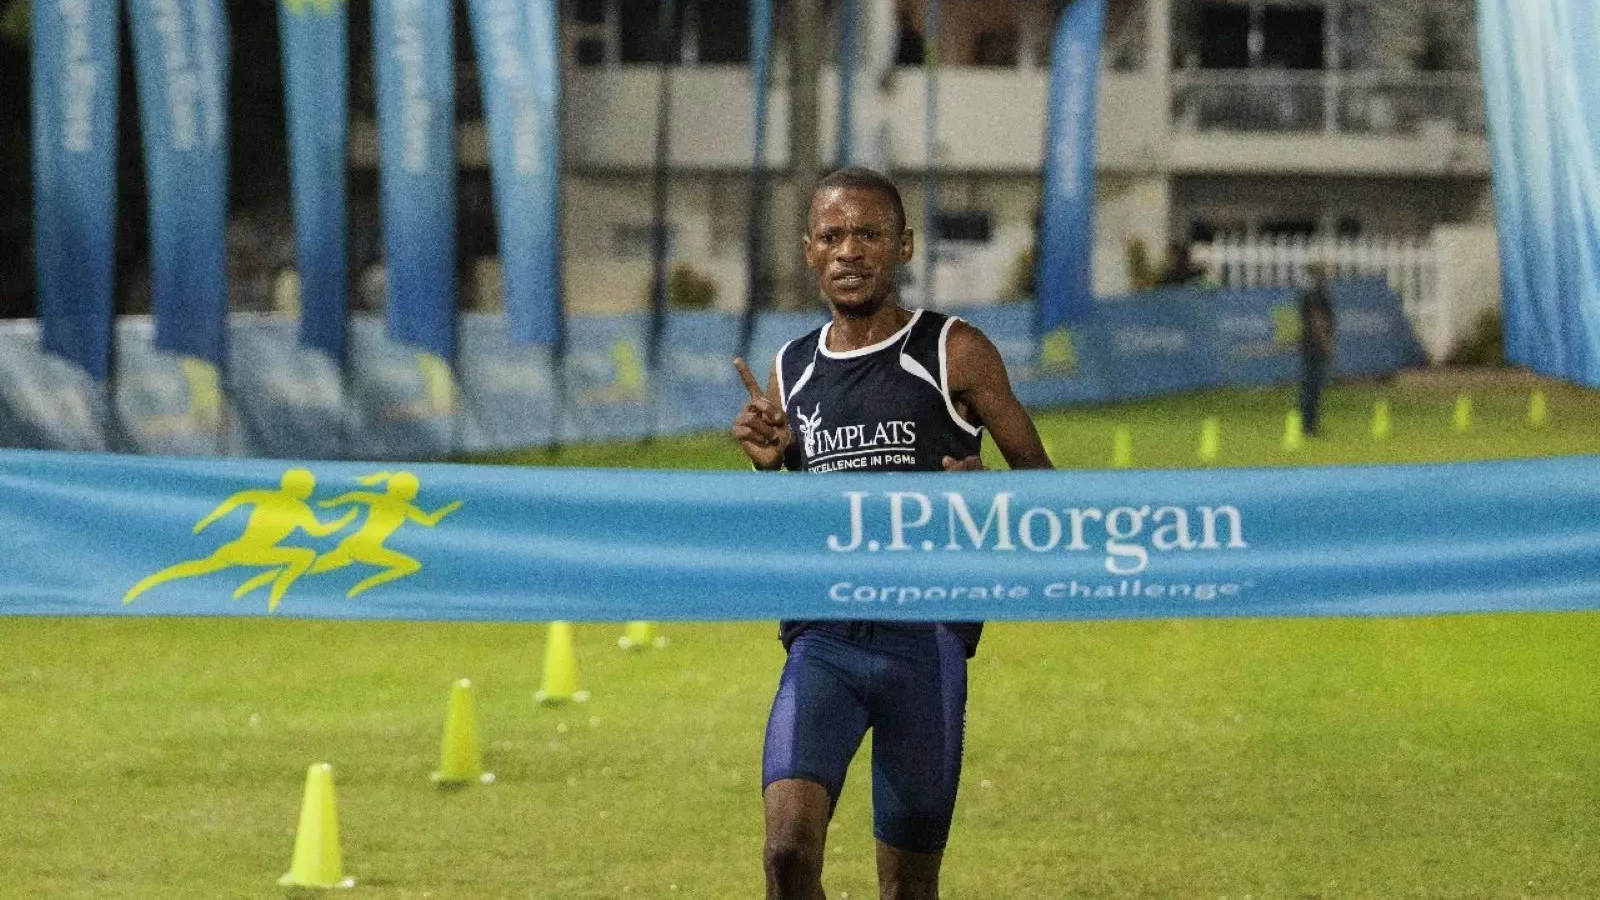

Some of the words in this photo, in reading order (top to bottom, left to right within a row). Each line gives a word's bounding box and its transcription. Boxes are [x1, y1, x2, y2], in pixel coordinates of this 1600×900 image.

[815, 420, 916, 454] IMPLATS
[870, 455, 882, 466] IN
[828, 581, 1030, 604] Corporate
[1044, 579, 1240, 600] Challenge
